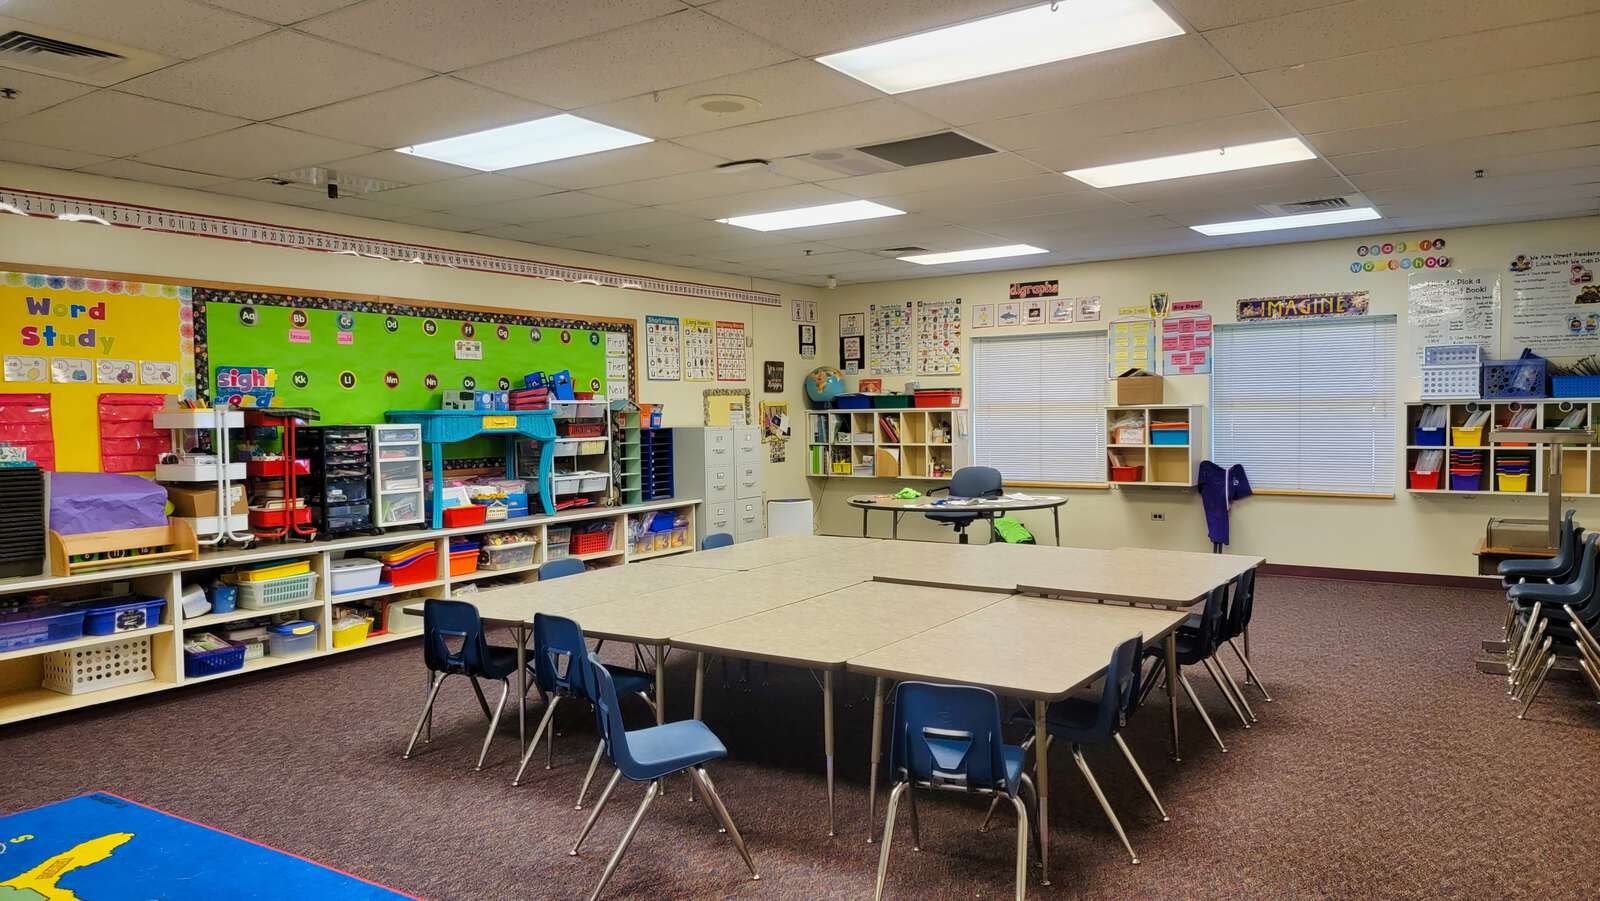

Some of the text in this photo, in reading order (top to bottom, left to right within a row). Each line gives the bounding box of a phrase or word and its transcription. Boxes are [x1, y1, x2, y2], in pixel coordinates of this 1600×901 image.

[50, 203, 56, 213] 0
[113, 210, 117, 220] 5
[125, 212, 129, 221] 6
[136, 214, 140, 224] 7
[148, 216, 152, 224] 8
[159, 217, 163, 226] 9
[169, 218, 175, 228] 10
[190, 221, 195, 231] 12
[201, 222, 207, 232] 13
[222, 225, 228, 234] 15
[242, 228, 247, 236] 17
[271, 232, 276, 240] 20
[1350, 256, 1449, 273] Wokshop
[1010, 281, 1058, 297] digraphs
[26, 296, 106, 320] Word
[1260, 296, 1344, 317] IMAGINE
[242, 312, 255, 320] Aa
[293, 314, 305, 323] Bb
[340, 317, 351, 325] Cc
[387, 320, 397, 328] Dd
[498, 329, 508, 338] Gg
[21, 325, 115, 354] Study
[608, 337, 625, 346] First
[608, 361, 625, 371] Then
[217, 368, 277, 392] sight
[295, 375, 307, 384] Kk
[386, 376, 398, 384] Mm
[609, 385, 626, 394] Next
